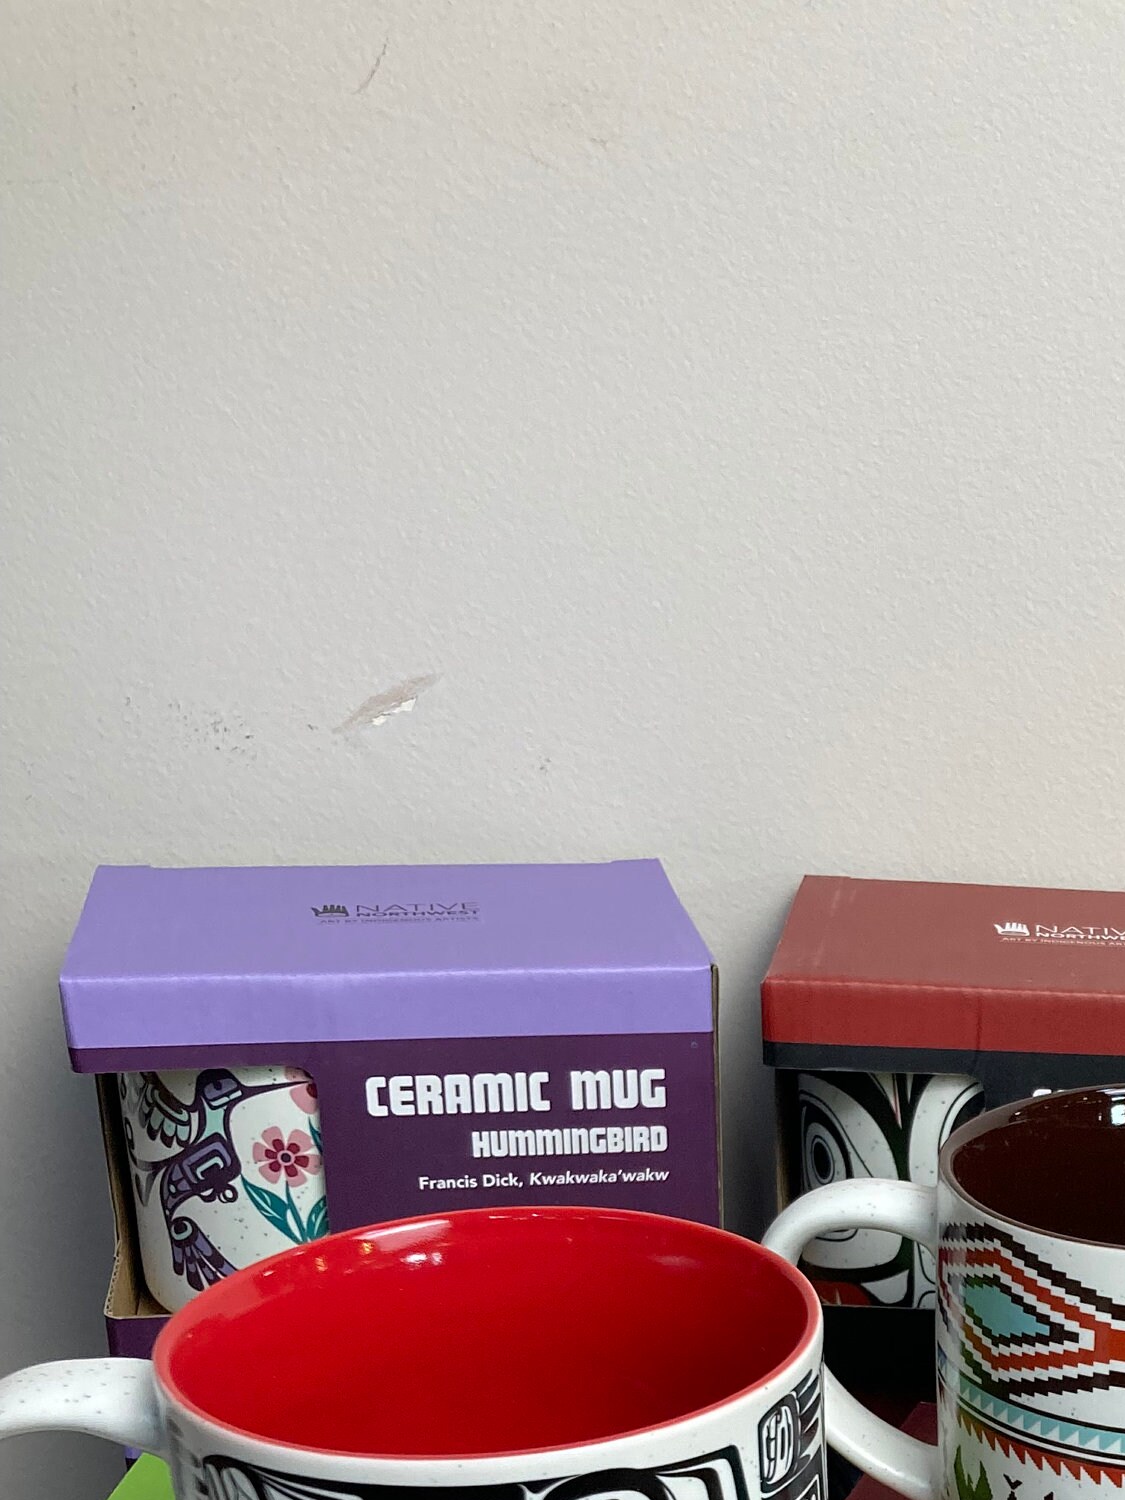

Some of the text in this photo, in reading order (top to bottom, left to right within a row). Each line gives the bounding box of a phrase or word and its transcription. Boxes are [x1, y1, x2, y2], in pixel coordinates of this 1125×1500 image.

[356, 902, 479, 912] NATIVE
[366, 1068, 667, 1117] CERAMIC MUG
[471, 1125, 668, 1158] HUMMINGBIRD
[419, 1176, 478, 1190] Francis
[482, 1174, 523, 1188] Dick,
